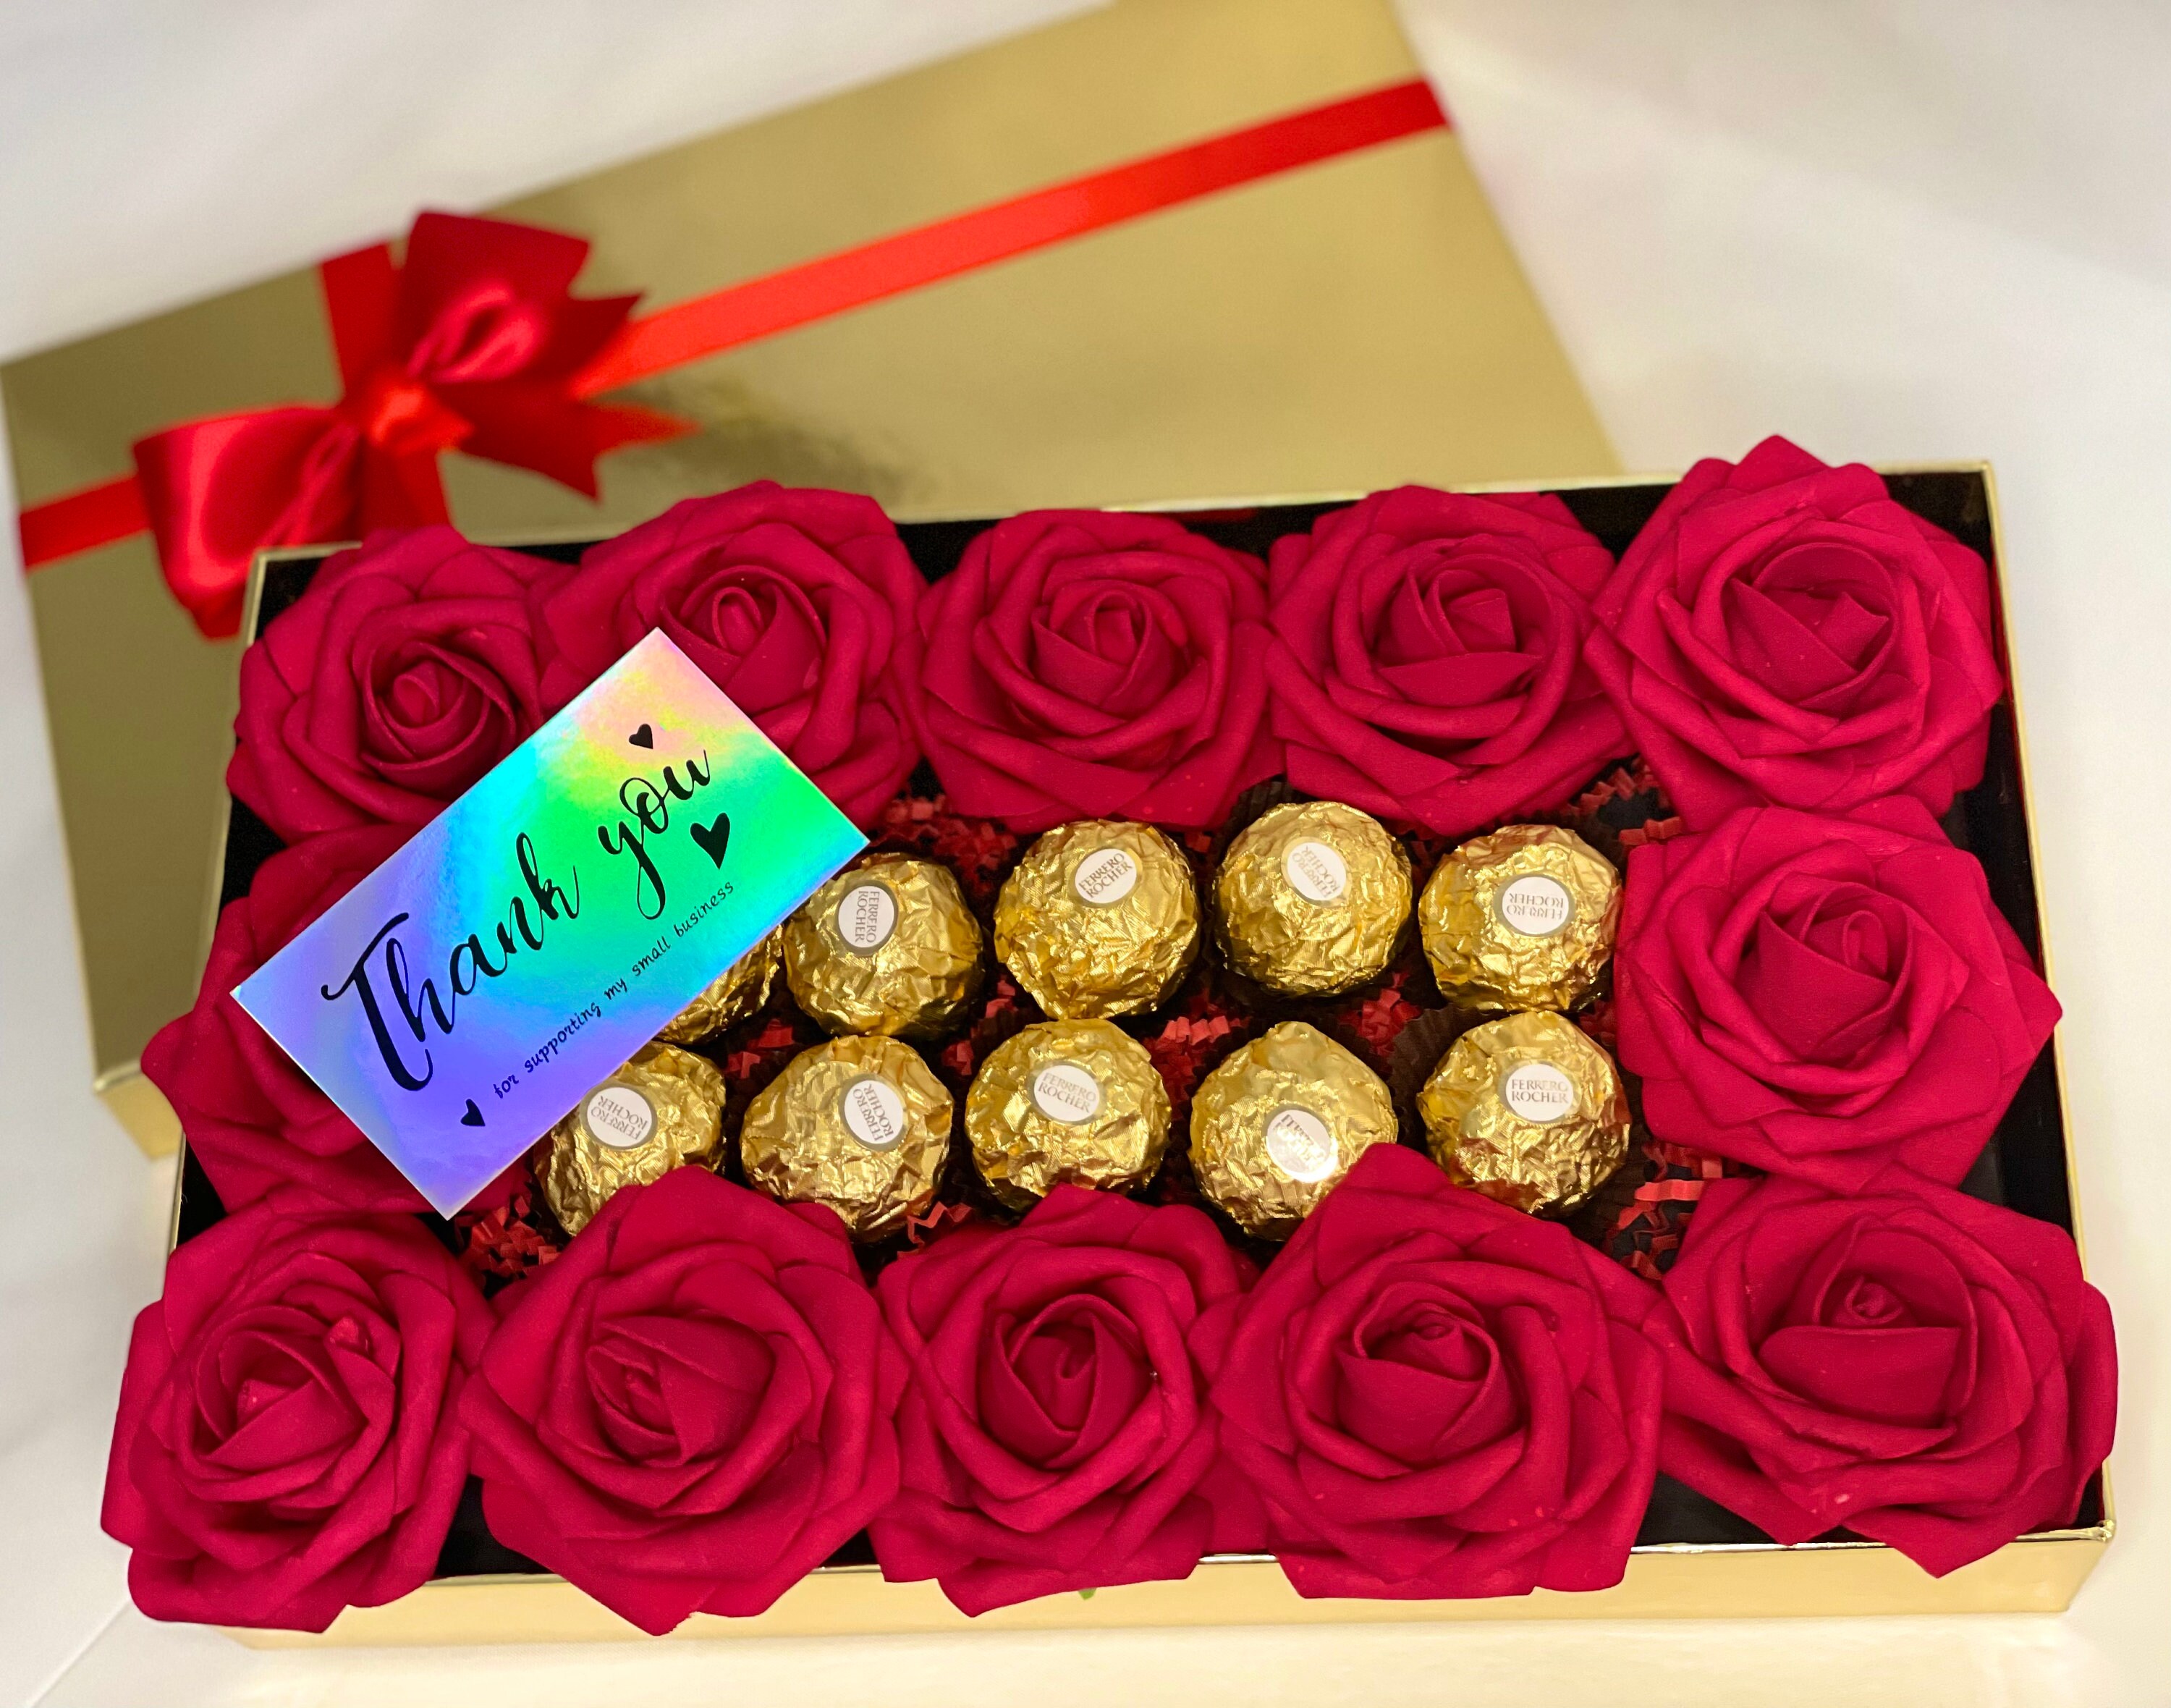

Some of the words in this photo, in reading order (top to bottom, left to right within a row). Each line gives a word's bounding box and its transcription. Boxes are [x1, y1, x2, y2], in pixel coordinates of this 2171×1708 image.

[1078, 853, 1125, 891] FERRERO
[1086, 861, 1133, 898] ROCHER
[855, 890, 869, 943] ROCHER
[866, 891, 880, 943] FERRERO
[1509, 892, 1564, 908] ROCHER
[321, 832, 580, 1091] Thank
[598, 750, 710, 920] you
[494, 1074, 519, 1099] for
[524, 1002, 602, 1073] supporting
[604, 978, 628, 999] my
[632, 936, 672, 976] small
[674, 881, 734, 937] business
[1038, 1081, 1091, 1113] ROCHER
[1042, 1072, 1097, 1102] FERRERO
[1511, 1078, 1569, 1092] FERRERO
[1511, 1091, 1569, 1104] ROCHER
[591, 1106, 642, 1140] FERRERO
[598, 1095, 648, 1130] ROCHER
[852, 1088, 884, 1141] FERRERO
[863, 1083, 894, 1137] ROCHER
